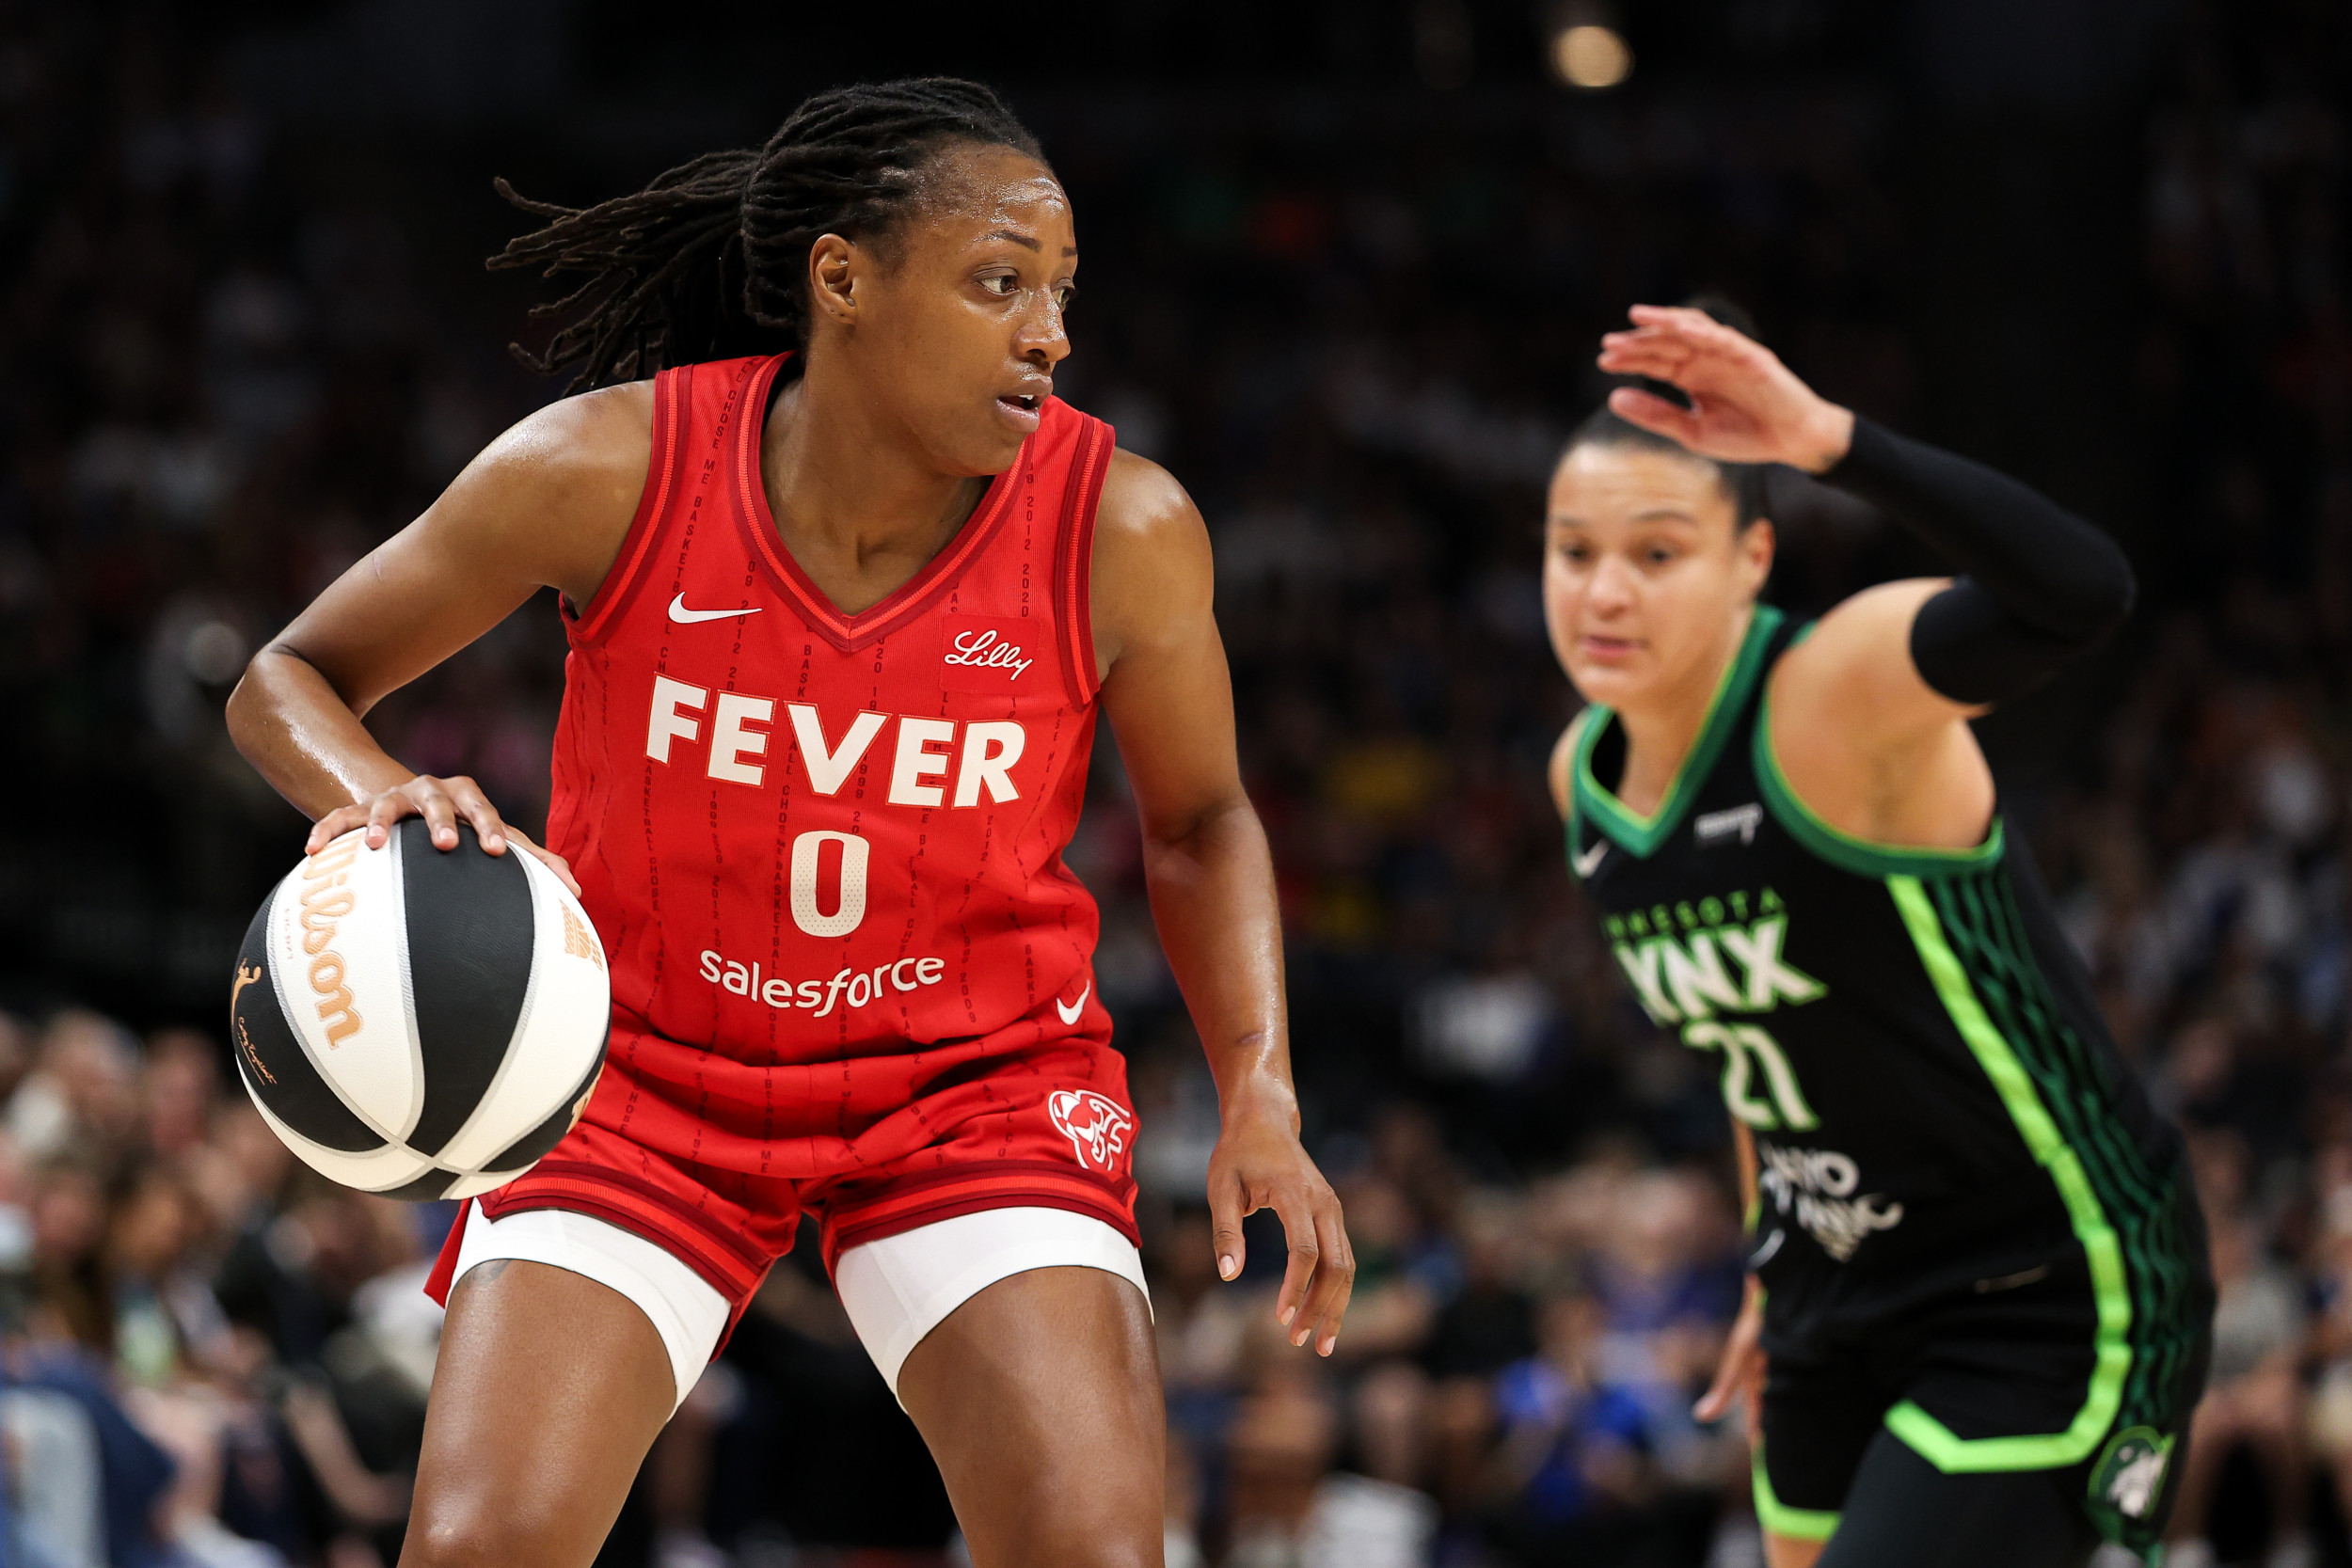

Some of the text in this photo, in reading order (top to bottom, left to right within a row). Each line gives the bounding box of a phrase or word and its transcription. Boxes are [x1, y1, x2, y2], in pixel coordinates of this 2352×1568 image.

[664, 390, 736, 635] CHOSE ME BASKETBL
[1024, 497, 1035, 550] 2012
[744, 561, 756, 587] 09
[1021, 564, 1030, 617] 2020
[944, 629, 1034, 681] Lilly
[644, 672, 1026, 809] FEVER
[643, 760, 655, 852] ASKETBALL
[790, 831, 870, 937] 0
[298, 833, 365, 1051] Wilson
[699, 949, 945, 1018] salesforce
[1612, 911, 1830, 1028] YNX
[1679, 1018, 1822, 1132] 21
